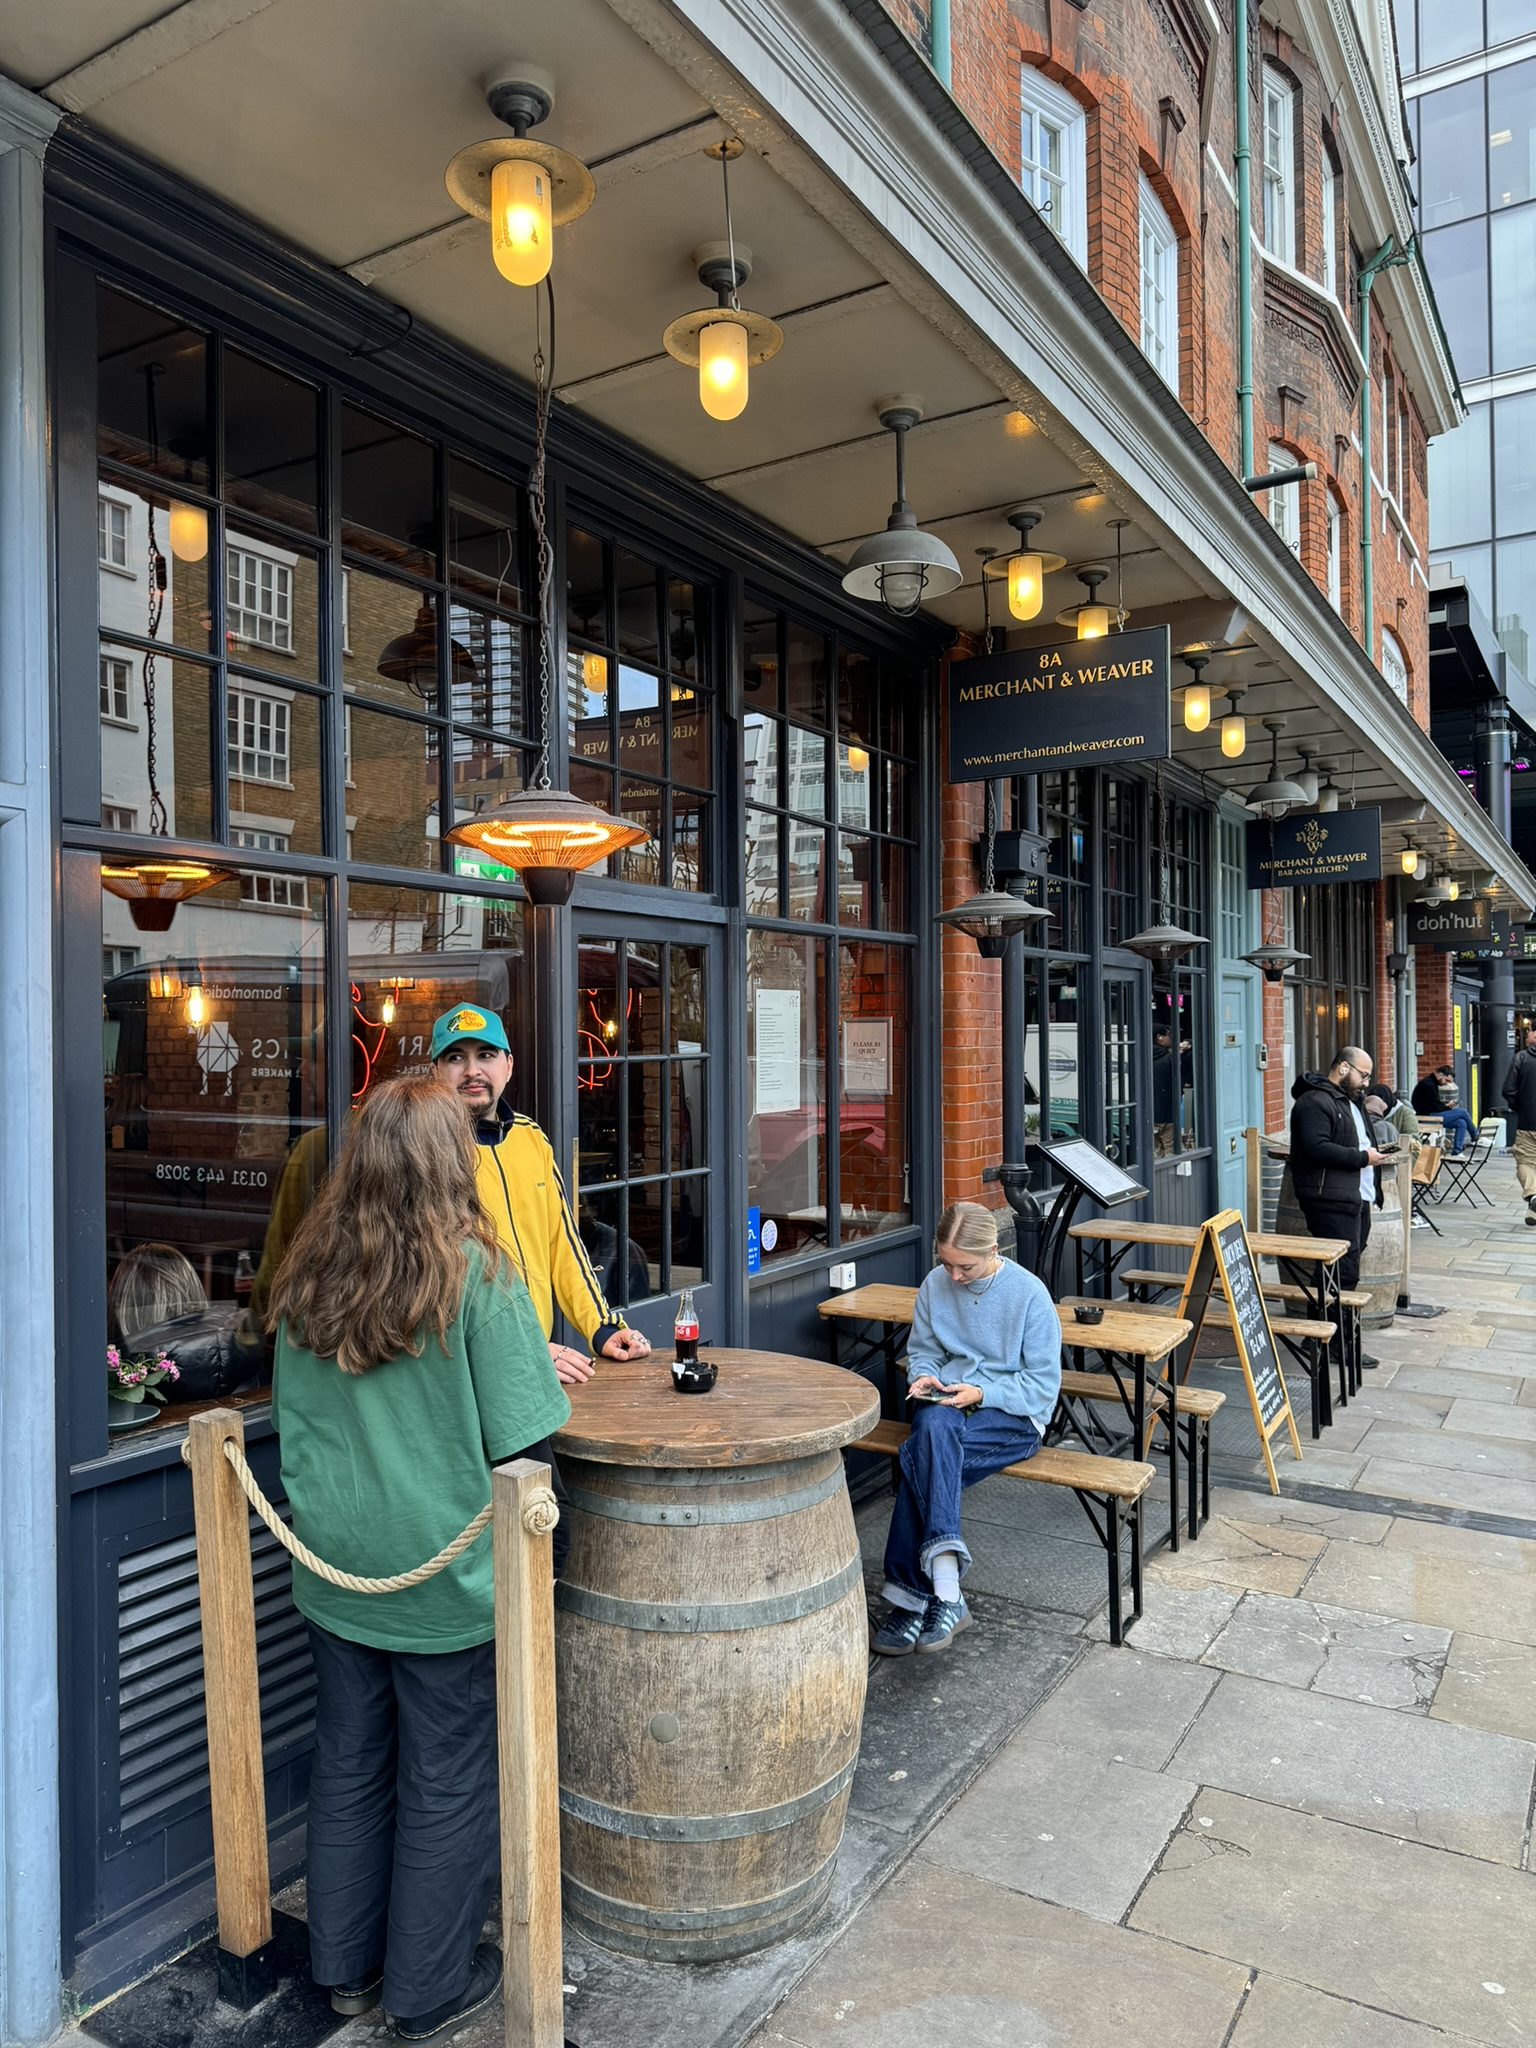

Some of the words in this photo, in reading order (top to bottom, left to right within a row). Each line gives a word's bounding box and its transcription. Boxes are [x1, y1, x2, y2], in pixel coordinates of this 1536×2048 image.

[1039, 652, 1063, 669] 8A
[959, 674, 1056, 702] MERCHANT
[1060, 671, 1074, 687] &
[1077, 659, 1154, 685] WEAVER
[963, 733, 1145, 767] www.merchantandweaver.com
[1316, 856, 1325, 865] &
[1326, 852, 1367, 864] WEAVER
[1278, 869, 1293, 877] BAR
[1294, 867, 1313, 876] AND
[1314, 864, 1349, 874] KITCHEN
[1417, 912, 1483, 932] doh'hut
